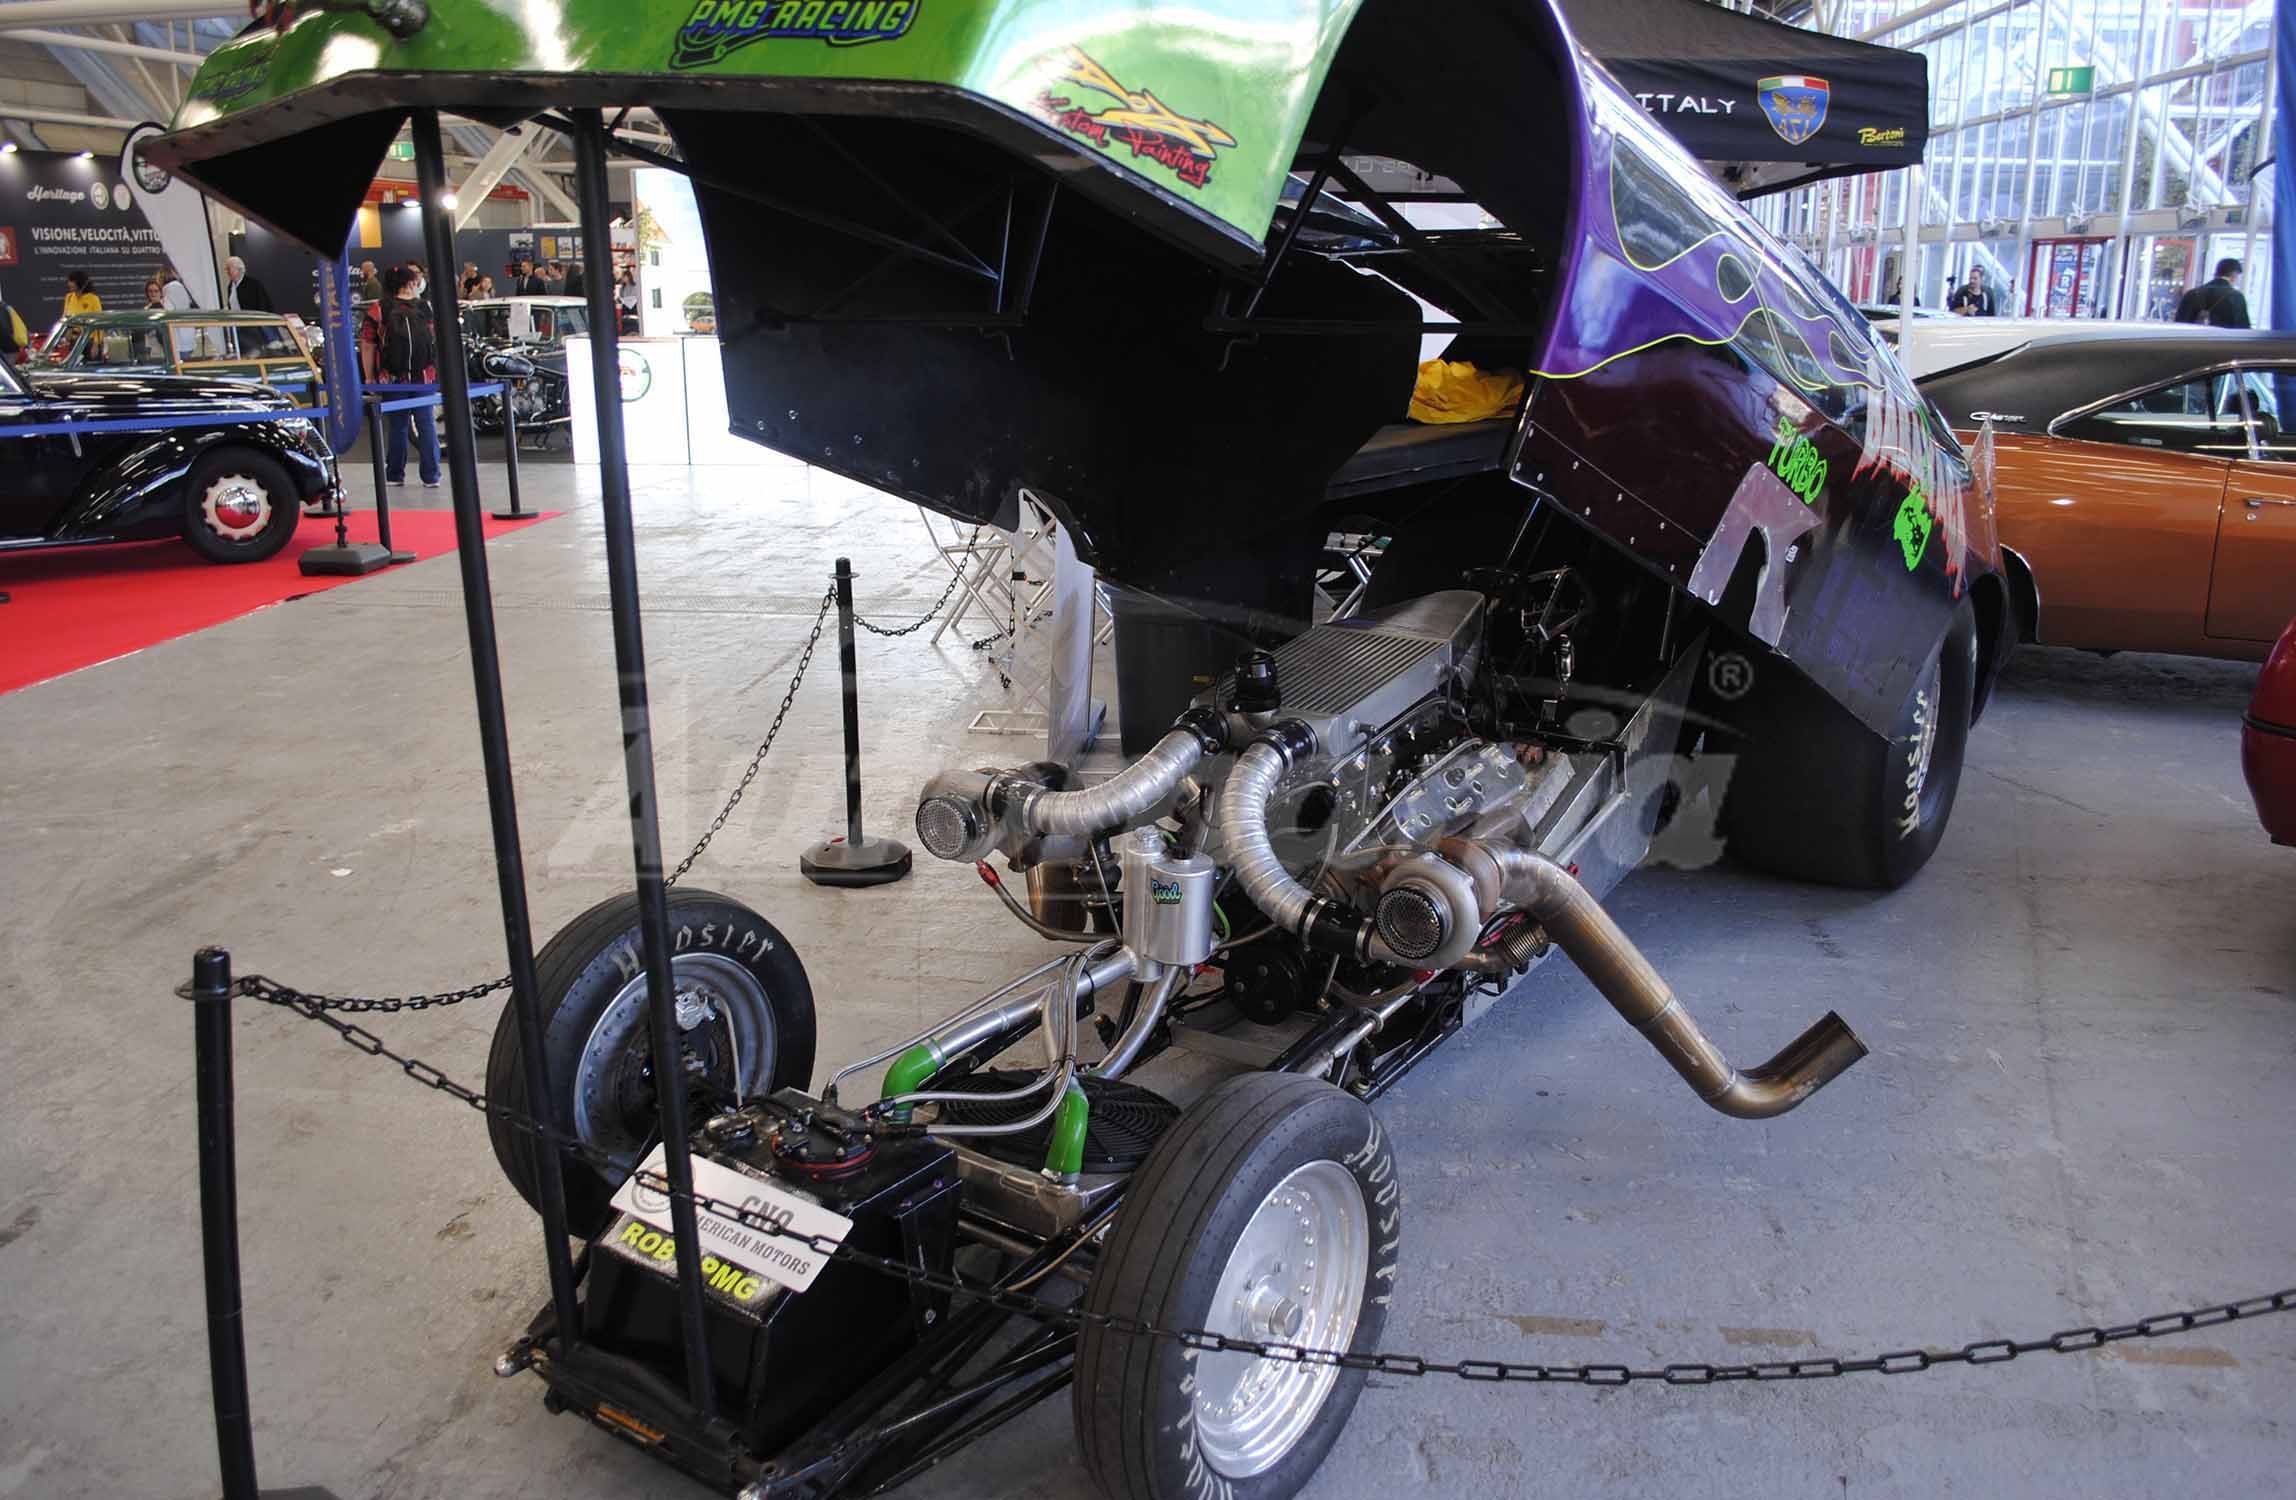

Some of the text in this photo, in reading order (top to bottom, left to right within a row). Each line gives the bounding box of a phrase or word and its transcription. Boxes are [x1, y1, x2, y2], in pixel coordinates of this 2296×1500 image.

[687, 0, 911, 32] PMG RACING
[1635, 93, 1736, 114] ITALY
[750, 1239, 811, 1276] MOTORS
